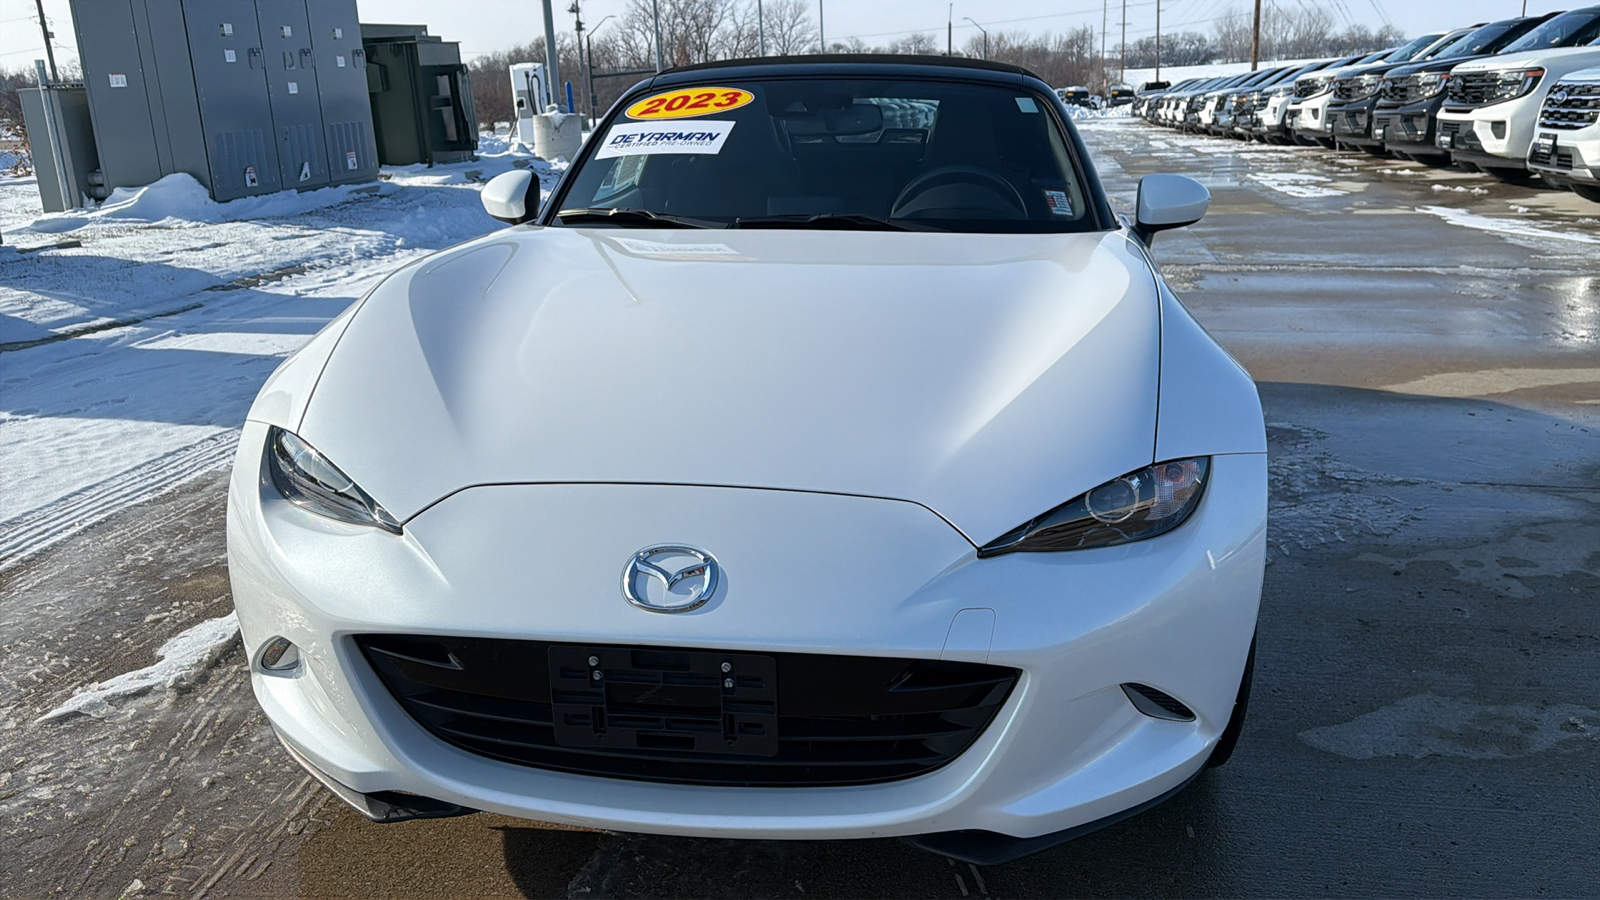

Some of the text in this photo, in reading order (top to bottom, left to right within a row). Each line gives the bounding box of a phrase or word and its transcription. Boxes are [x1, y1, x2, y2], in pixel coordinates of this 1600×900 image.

[637, 91, 743, 117] 2023
[609, 132, 722, 145] DEYARMAN
[614, 141, 659, 149] CERTIFIED
